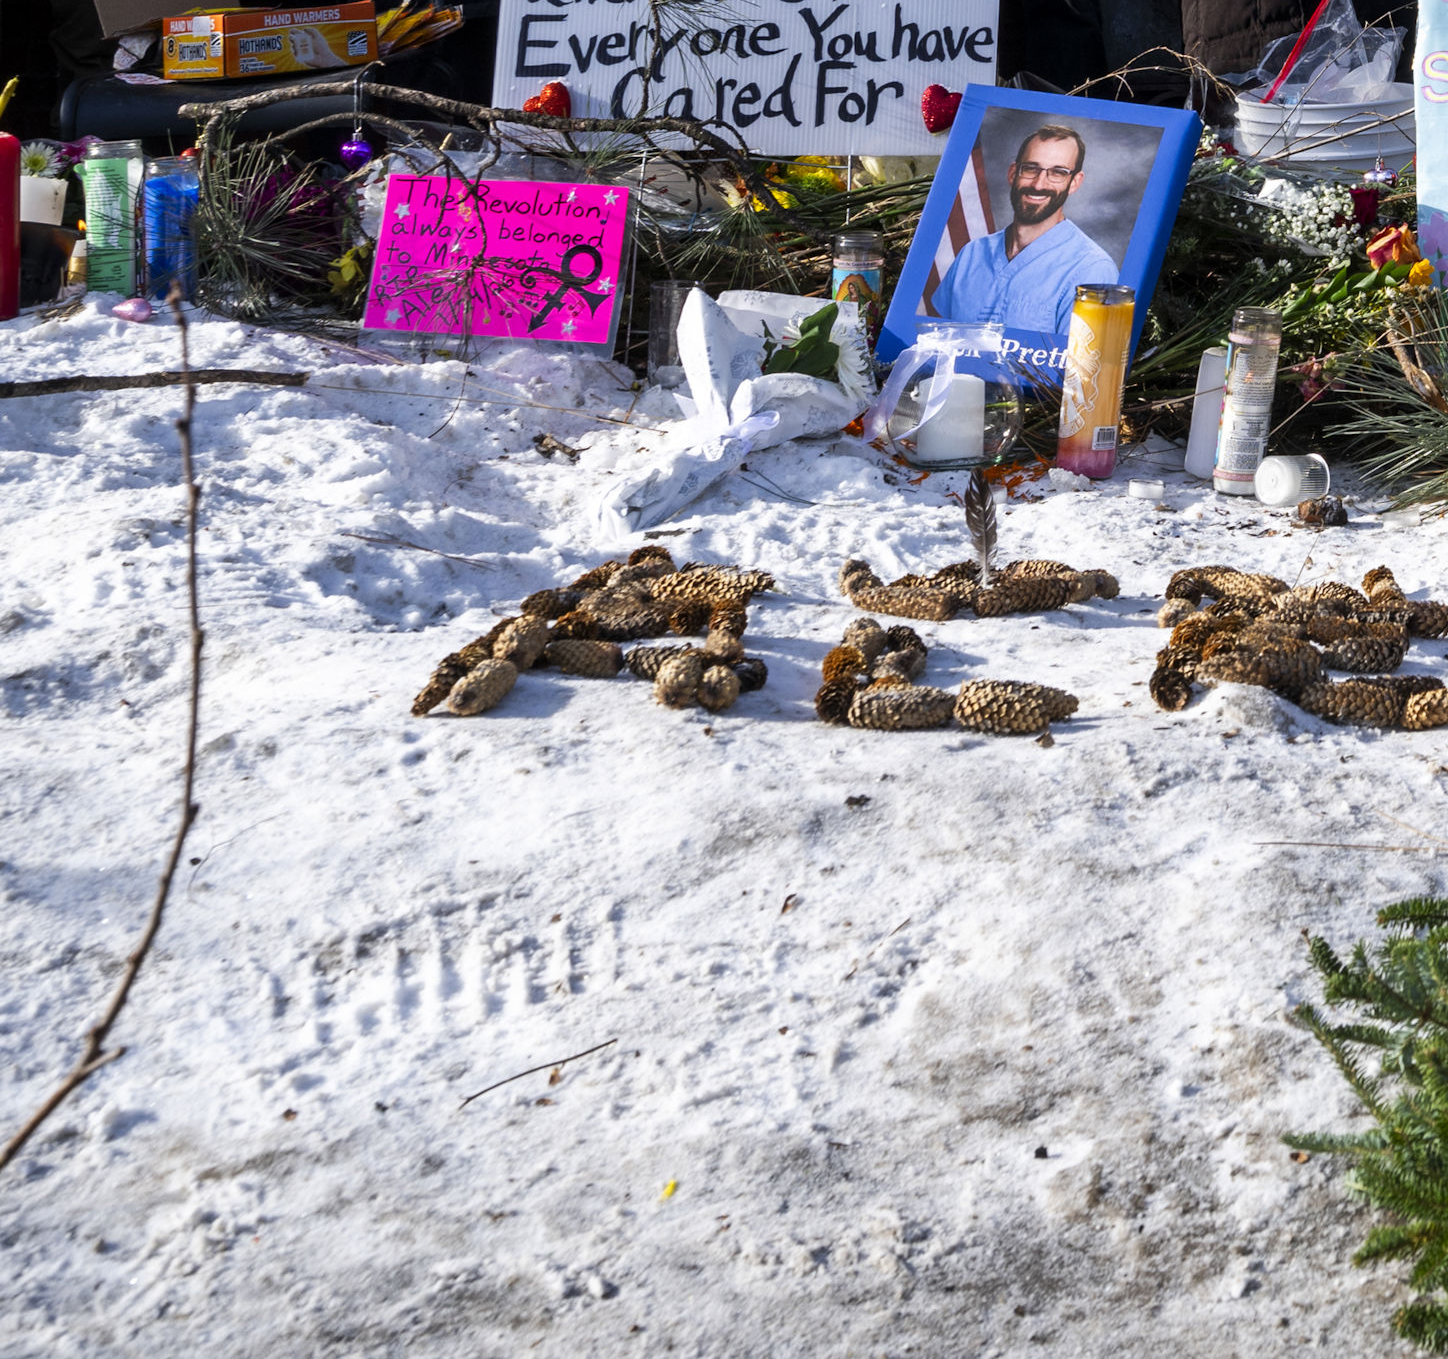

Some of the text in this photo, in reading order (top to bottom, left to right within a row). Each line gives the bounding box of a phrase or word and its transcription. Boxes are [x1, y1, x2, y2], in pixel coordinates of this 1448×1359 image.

[264, 9, 341, 26] HAND WARMERS
[239, 36, 283, 55] HOTHANDS
[516, 4, 995, 83] Everyone You have
[240, 64, 250, 73] 36
[610, 53, 904, 128] Cared For
[396, 178, 601, 220] The Revolution
[386, 240, 551, 271] to Minesota
[391, 219, 605, 258] always belonged
[402, 285, 447, 326] Ale
[994, 338, 1069, 369] Prett
